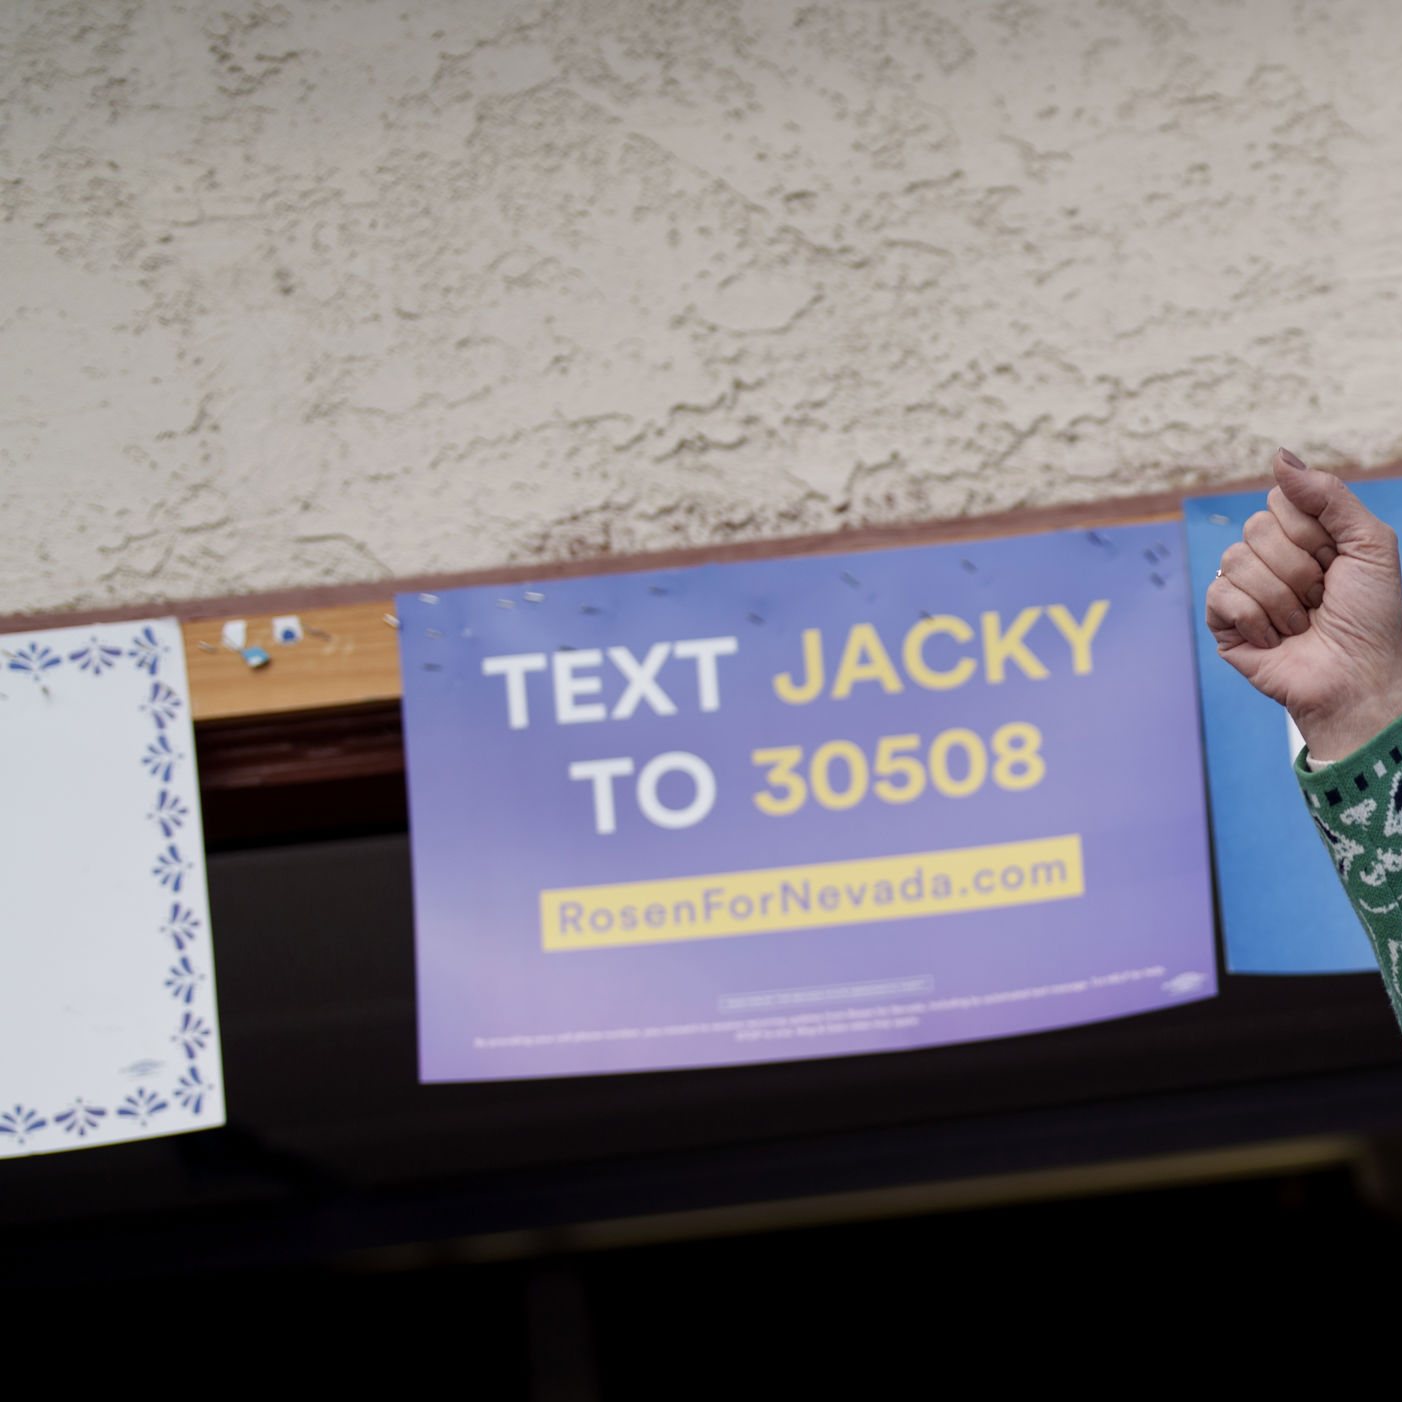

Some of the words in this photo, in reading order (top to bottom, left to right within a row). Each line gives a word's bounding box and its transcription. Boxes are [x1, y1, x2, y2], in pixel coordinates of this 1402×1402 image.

[483, 636, 738, 729] TEXT
[773, 600, 1111, 704] JACKY
[570, 751, 717, 835] TO
[752, 722, 1046, 816] 30508
[558, 857, 1068, 937] RosenForNevada.com
